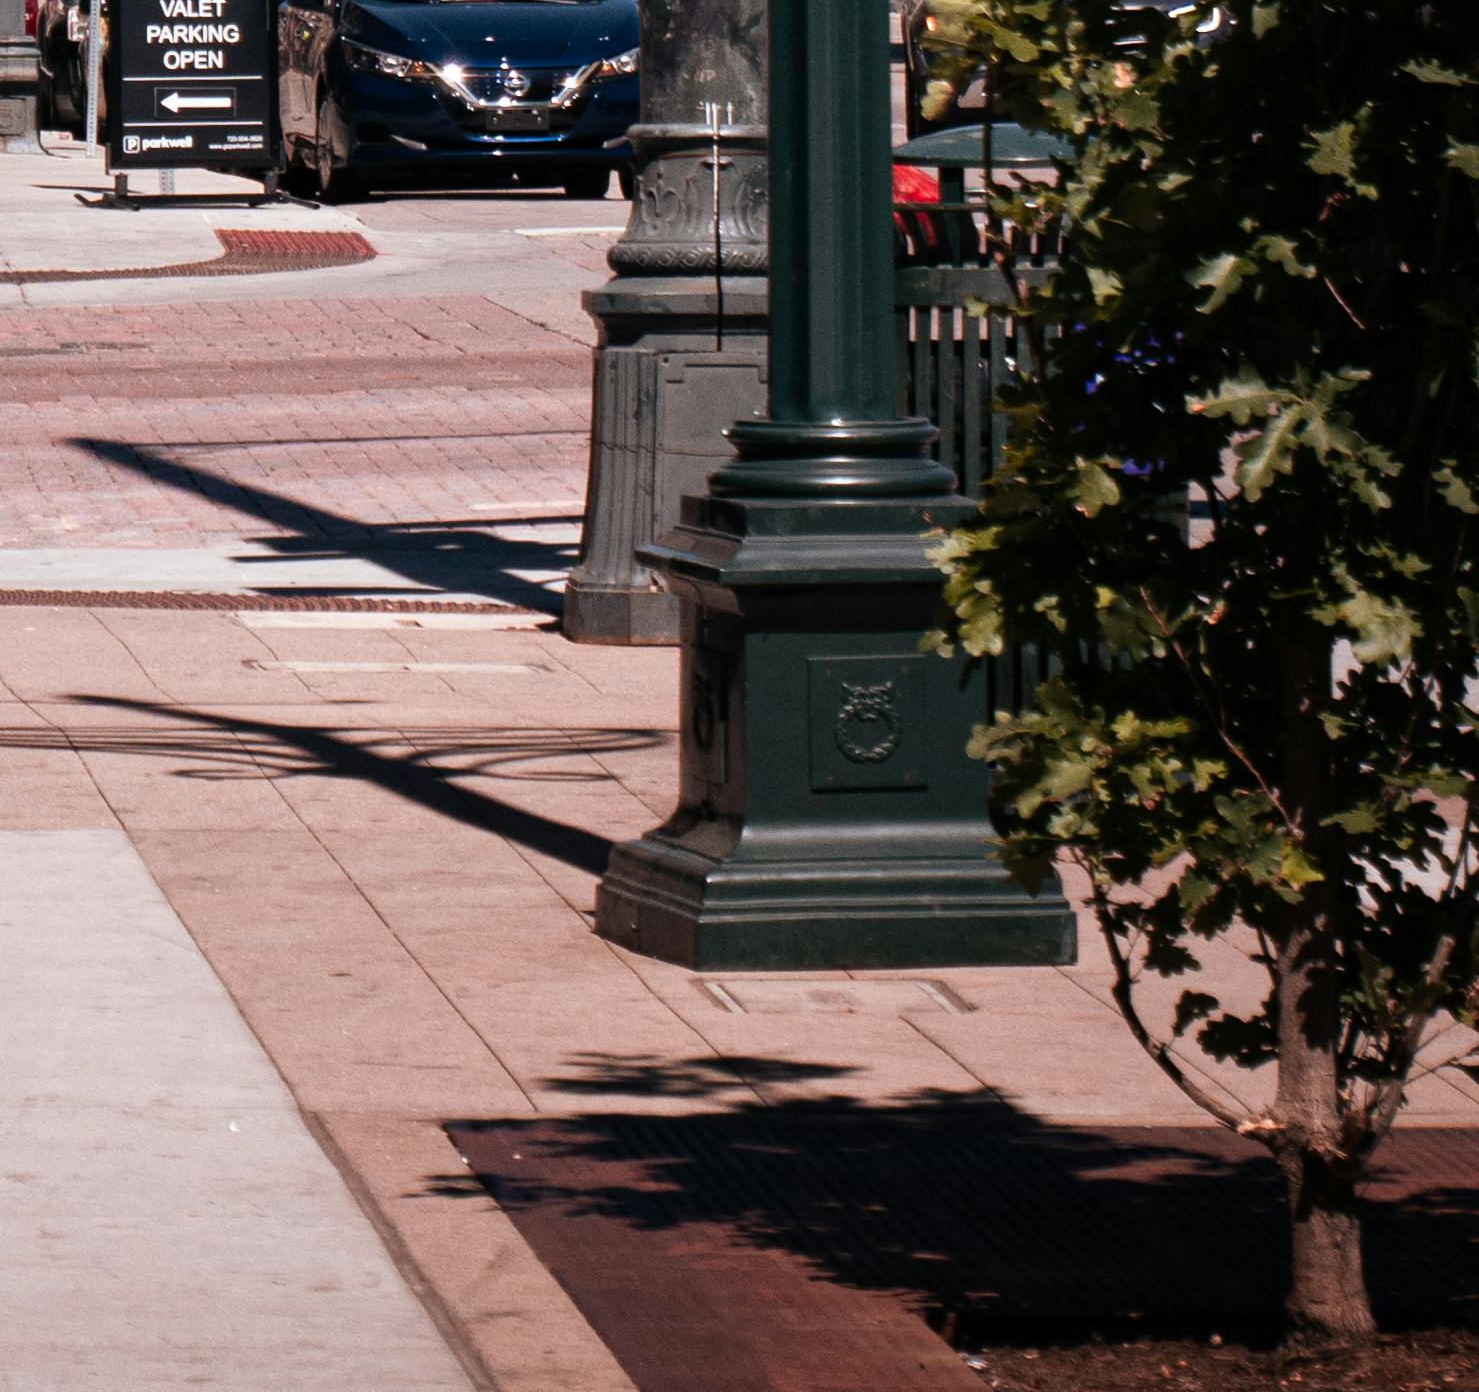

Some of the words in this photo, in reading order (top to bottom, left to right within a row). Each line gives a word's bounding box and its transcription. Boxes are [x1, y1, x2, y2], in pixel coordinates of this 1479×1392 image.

[146, 23, 241, 44] PARKING
[163, 50, 224, 70] OPEN
[142, 135, 194, 152] parkwell
